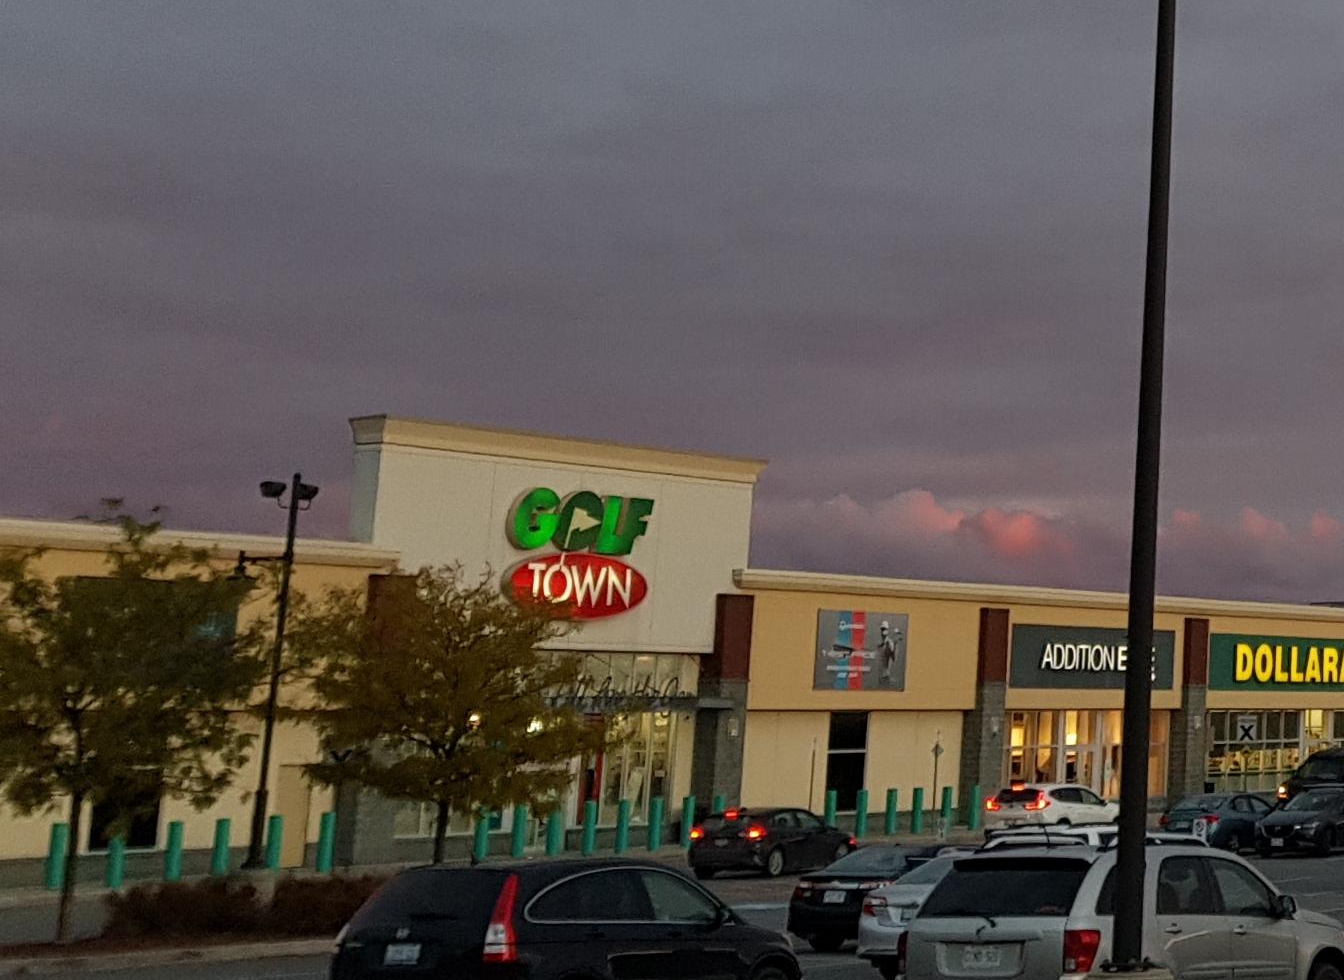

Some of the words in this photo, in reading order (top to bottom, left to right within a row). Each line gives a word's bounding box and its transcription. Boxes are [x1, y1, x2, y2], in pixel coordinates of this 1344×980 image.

[506, 487, 655, 556] GOLF
[528, 563, 632, 608] TOWN
[1041, 643, 1115, 671] ADDITION
